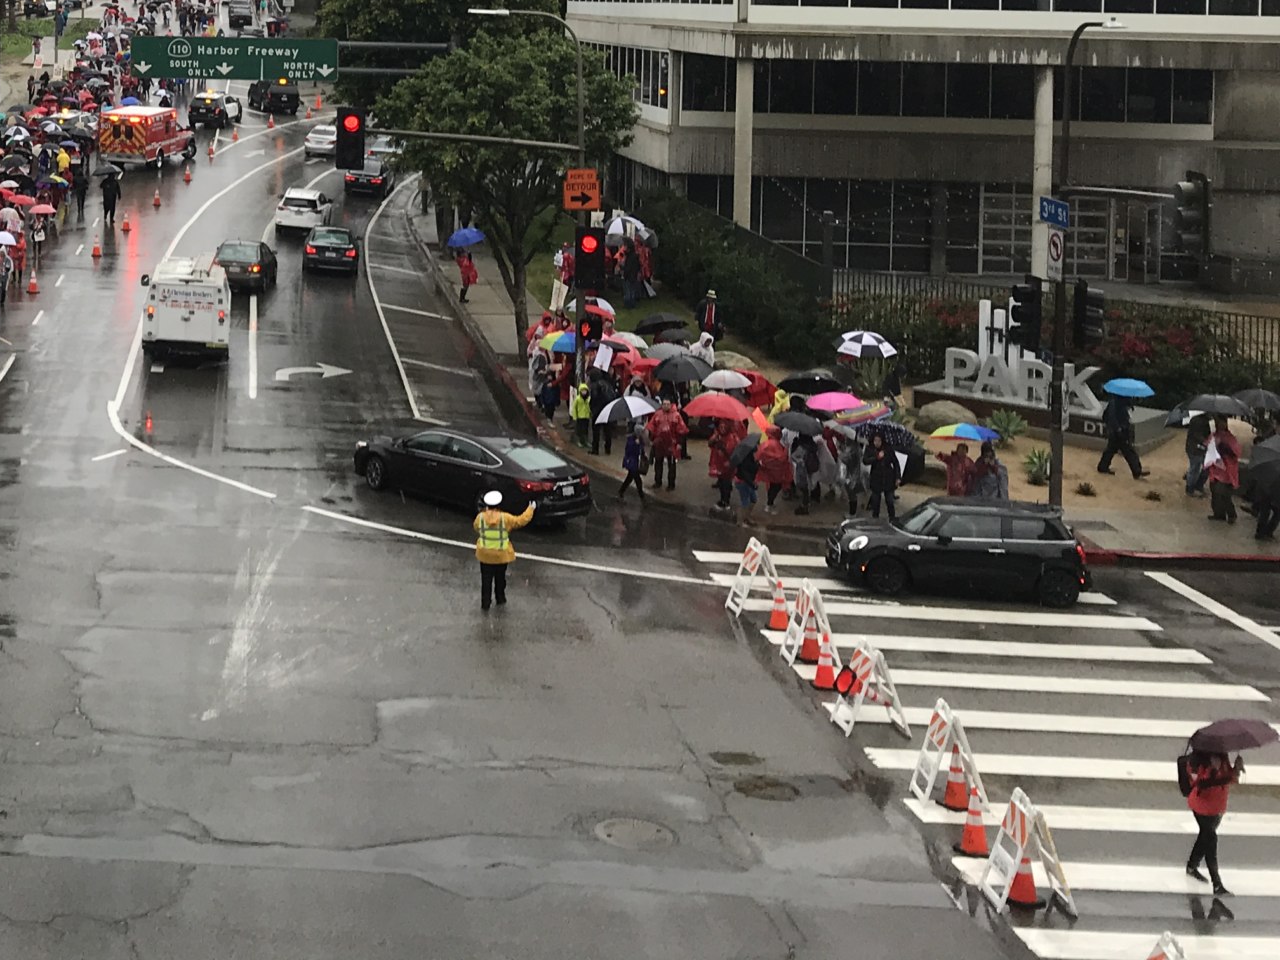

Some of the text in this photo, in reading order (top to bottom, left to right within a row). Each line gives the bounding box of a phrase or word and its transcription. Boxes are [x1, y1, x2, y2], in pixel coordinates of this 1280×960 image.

[171, 44, 299, 59] 110 Harbor Freeway
[169, 59, 199, 68] SOUTH
[283, 62, 315, 70] NORTH
[187, 69, 215, 77] ONLY
[288, 71, 315, 79] ONLY
[565, 183, 597, 191] DETOUR
[1041, 201, 1067, 222] 3rd St
[945, 346, 1103, 412] PARK
